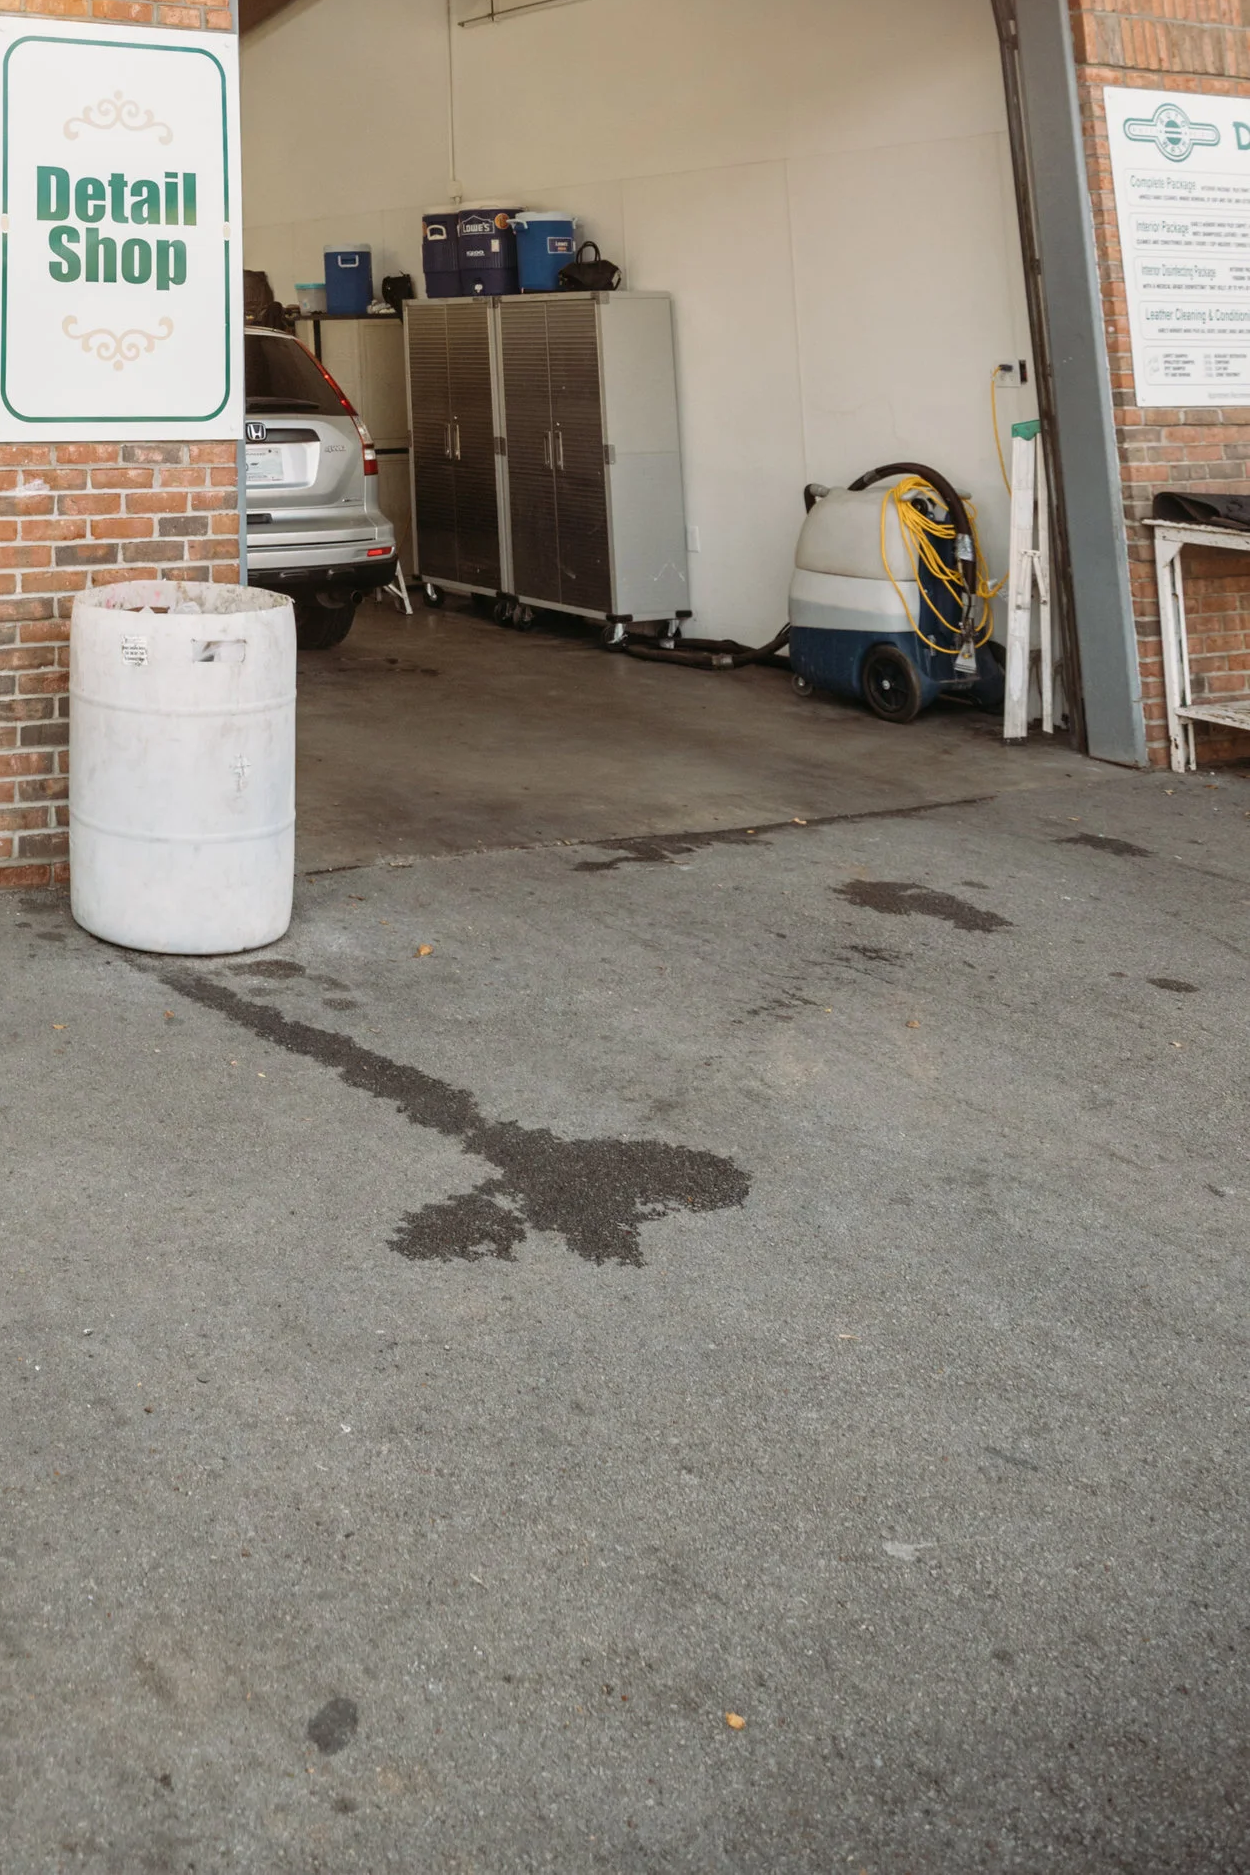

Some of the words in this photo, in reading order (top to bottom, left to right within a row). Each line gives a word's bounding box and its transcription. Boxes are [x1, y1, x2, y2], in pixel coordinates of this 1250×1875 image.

[1130, 174, 1165, 190] Complete
[1166, 176, 1196, 194] Package
[36, 165, 197, 226] Detail
[462, 222, 490, 233] LOWE'S
[1136, 220, 1160, 233] Interior
[1161, 220, 1190, 237] Package
[48, 225, 188, 291] Shop
[1145, 307, 1174, 321] Leather
[1175, 308, 1206, 325] Cleaning
